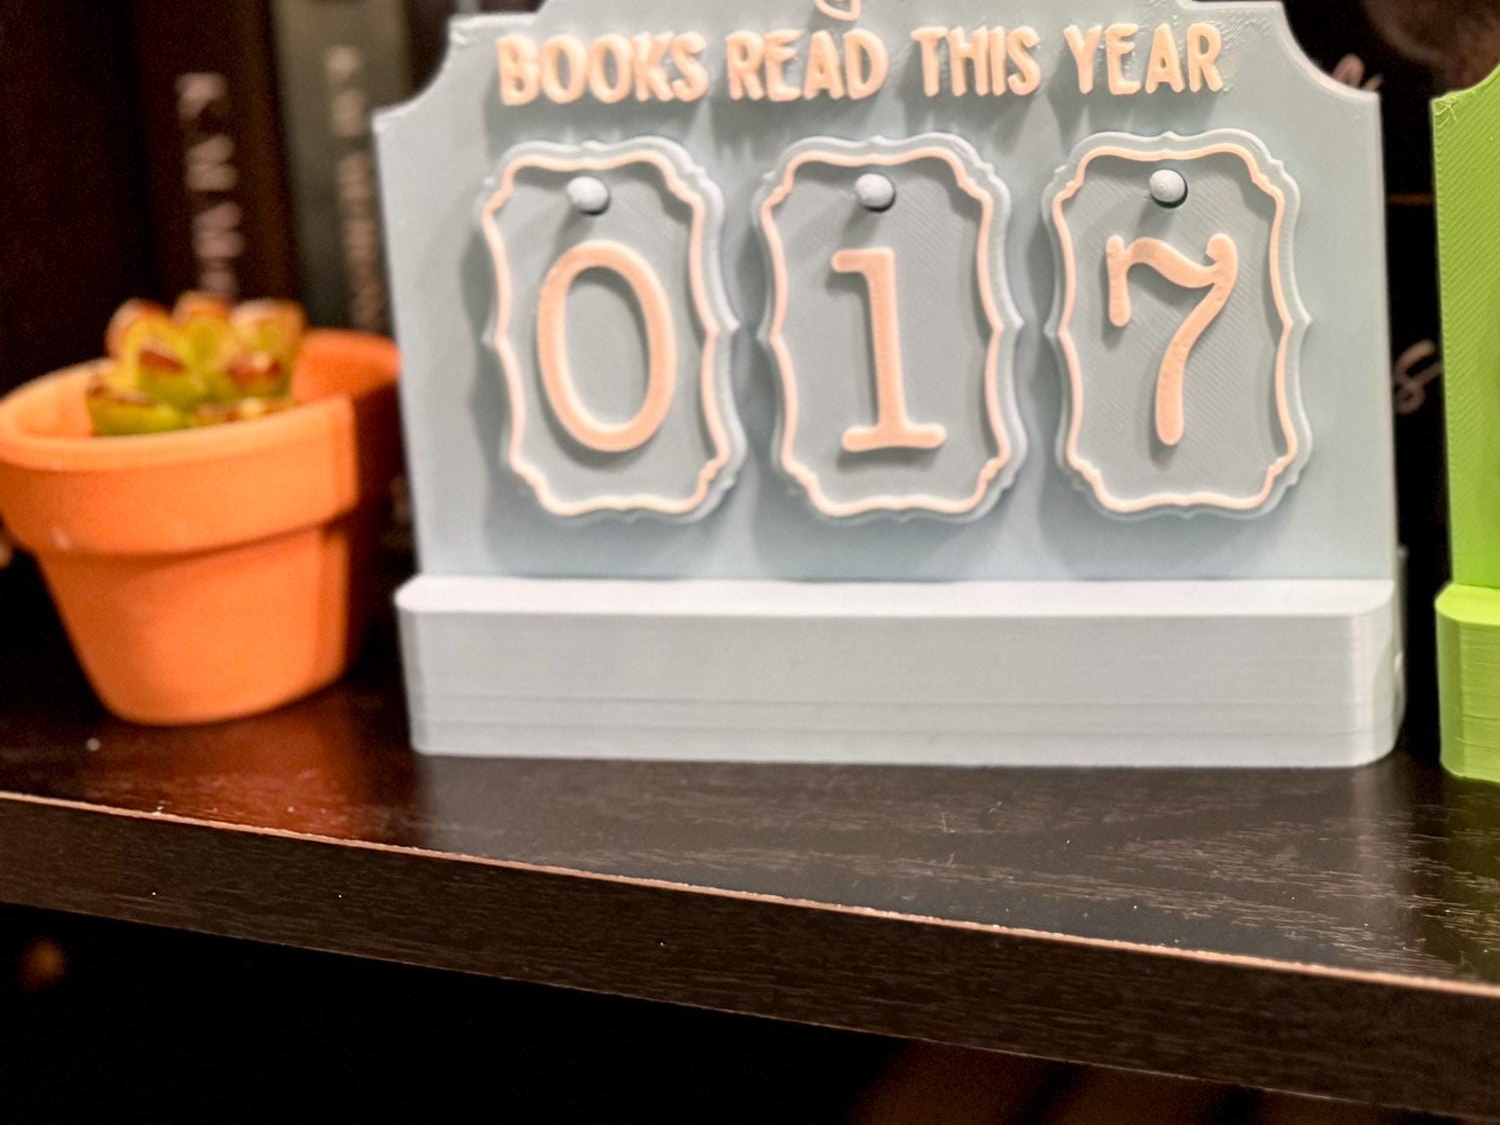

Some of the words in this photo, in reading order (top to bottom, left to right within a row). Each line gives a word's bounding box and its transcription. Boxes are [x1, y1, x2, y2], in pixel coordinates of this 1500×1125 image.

[496, 31, 708, 106] BOOKS
[726, 28, 889, 103] READ
[911, 24, 1041, 97] THIS
[1064, 22, 1224, 95] YEAR
